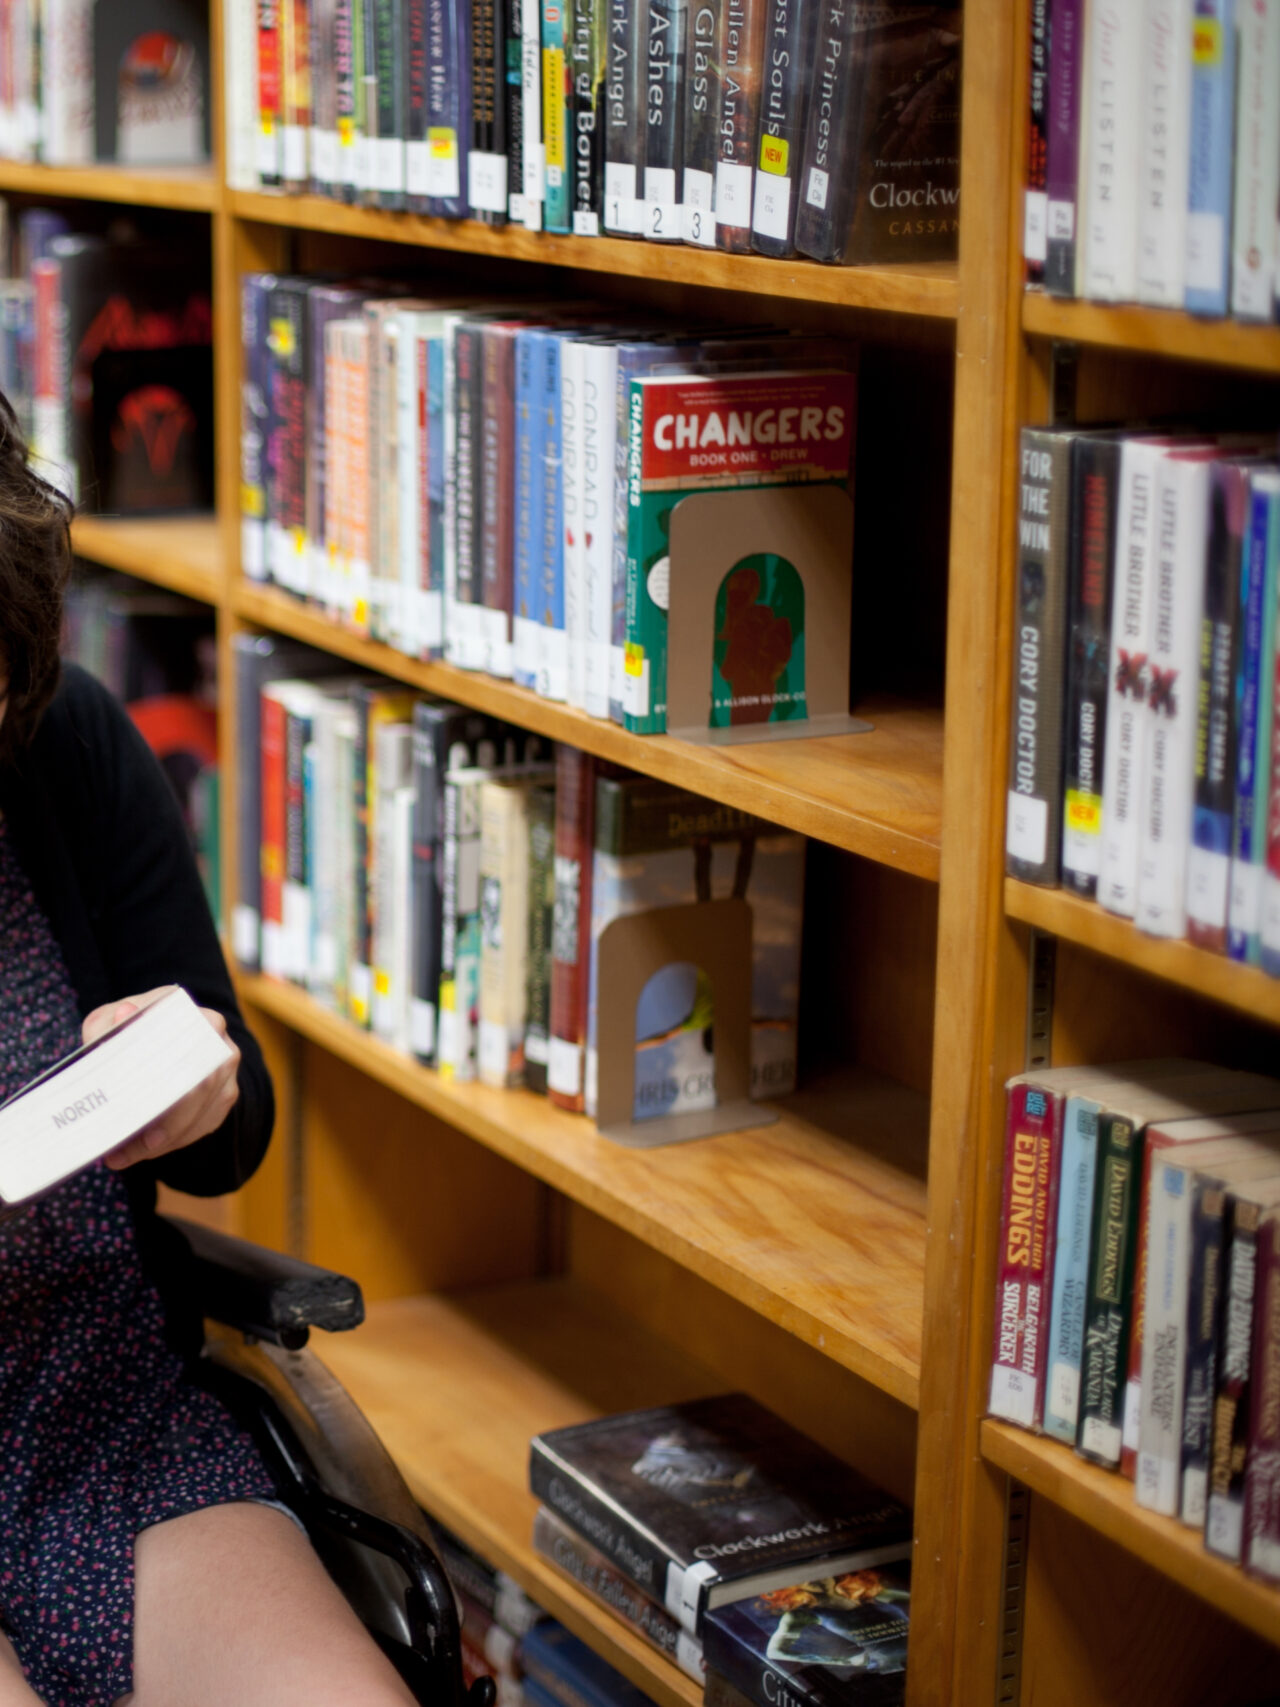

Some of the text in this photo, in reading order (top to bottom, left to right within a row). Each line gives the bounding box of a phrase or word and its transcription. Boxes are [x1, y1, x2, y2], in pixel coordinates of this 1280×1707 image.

[609, 43, 629, 127] Angel
[648, 8, 671, 127] Ashes
[693, 8, 715, 112] Glass
[721, 0, 745, 165] allen Angel
[767, 0, 790, 136] ost Souls
[816, 37, 842, 167] Princess
[1032, 71, 1048, 112] less
[576, 110, 596, 212] Bones
[764, 146, 784, 165] NEW
[1099, 79, 1115, 203] LISTEN
[1149, 83, 1167, 209] LISTEN
[611, 201, 619, 226] 1
[652, 207, 663, 234] 2
[691, 212, 702, 240] 3
[583, 379, 599, 521] CONRAD
[629, 391, 643, 508] CHANGERS
[652, 404, 846, 452] CHANGERS
[689, 447, 809, 467] BOOK ONE DREW
[1022, 448, 1052, 480] FOR
[1019, 520, 1050, 551] WIN
[1021, 484, 1050, 516] THE
[1082, 473, 1107, 607] HOMELAND
[1124, 473, 1151, 638] LITTLE BROTHER
[1156, 486, 1178, 654] LITTLE BROTHER
[1018, 625, 1040, 693] CORY
[1079, 701, 1096, 745] CORY
[1120, 710, 1134, 753] CORY
[1209, 622, 1232, 783] PIRATE CINEMA
[1154, 729, 1168, 771] CORY
[1068, 803, 1096, 823] NEW
[51, 1088, 109, 1130] NORTH
[1007, 1132, 1039, 1267] EDDINGS
[1031, 1136, 1051, 1270] DAVID AND LEIGH
[1099, 1162, 1127, 1297] DAVID EDDINGS
[998, 1280, 1022, 1364] SORCERER
[1022, 1283, 1042, 1375] BELGARATH
[1057, 1277, 1075, 1359] WIZARDRY
[1102, 1311, 1122, 1375] DEMON
[1223, 1239, 1257, 1383] DAVID EDDINGS
[1085, 1328, 1111, 1407] KARANDA
[693, 1521, 829, 1560] Clockwork
